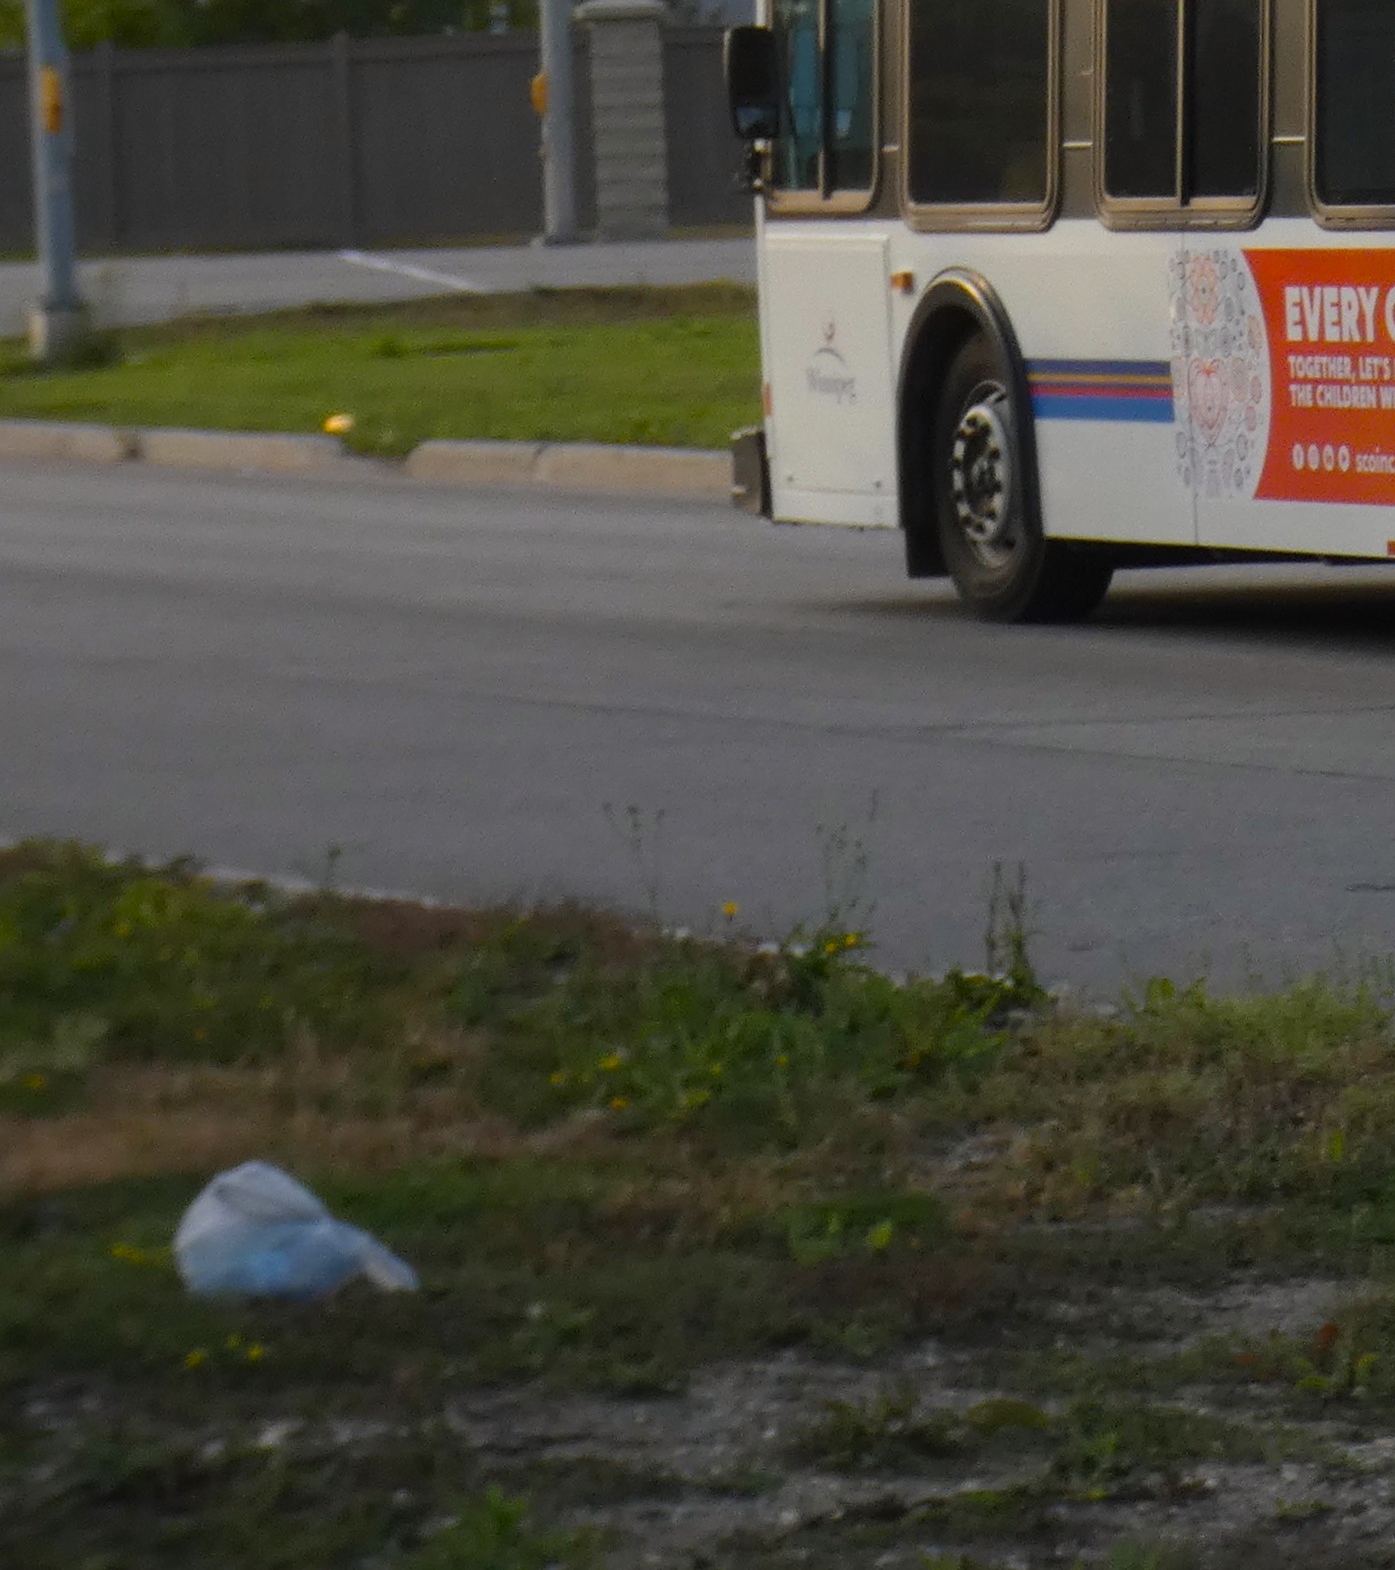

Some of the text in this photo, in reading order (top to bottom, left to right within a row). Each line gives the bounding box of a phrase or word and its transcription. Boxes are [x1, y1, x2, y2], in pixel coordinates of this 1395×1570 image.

[1284, 286, 1377, 343] EVERY
[1288, 355, 1355, 381] TOGETHER,
[1359, 356, 1390, 380] LET'S
[1289, 384, 1313, 407] THE
[1316, 384, 1377, 408] CHILDREN
